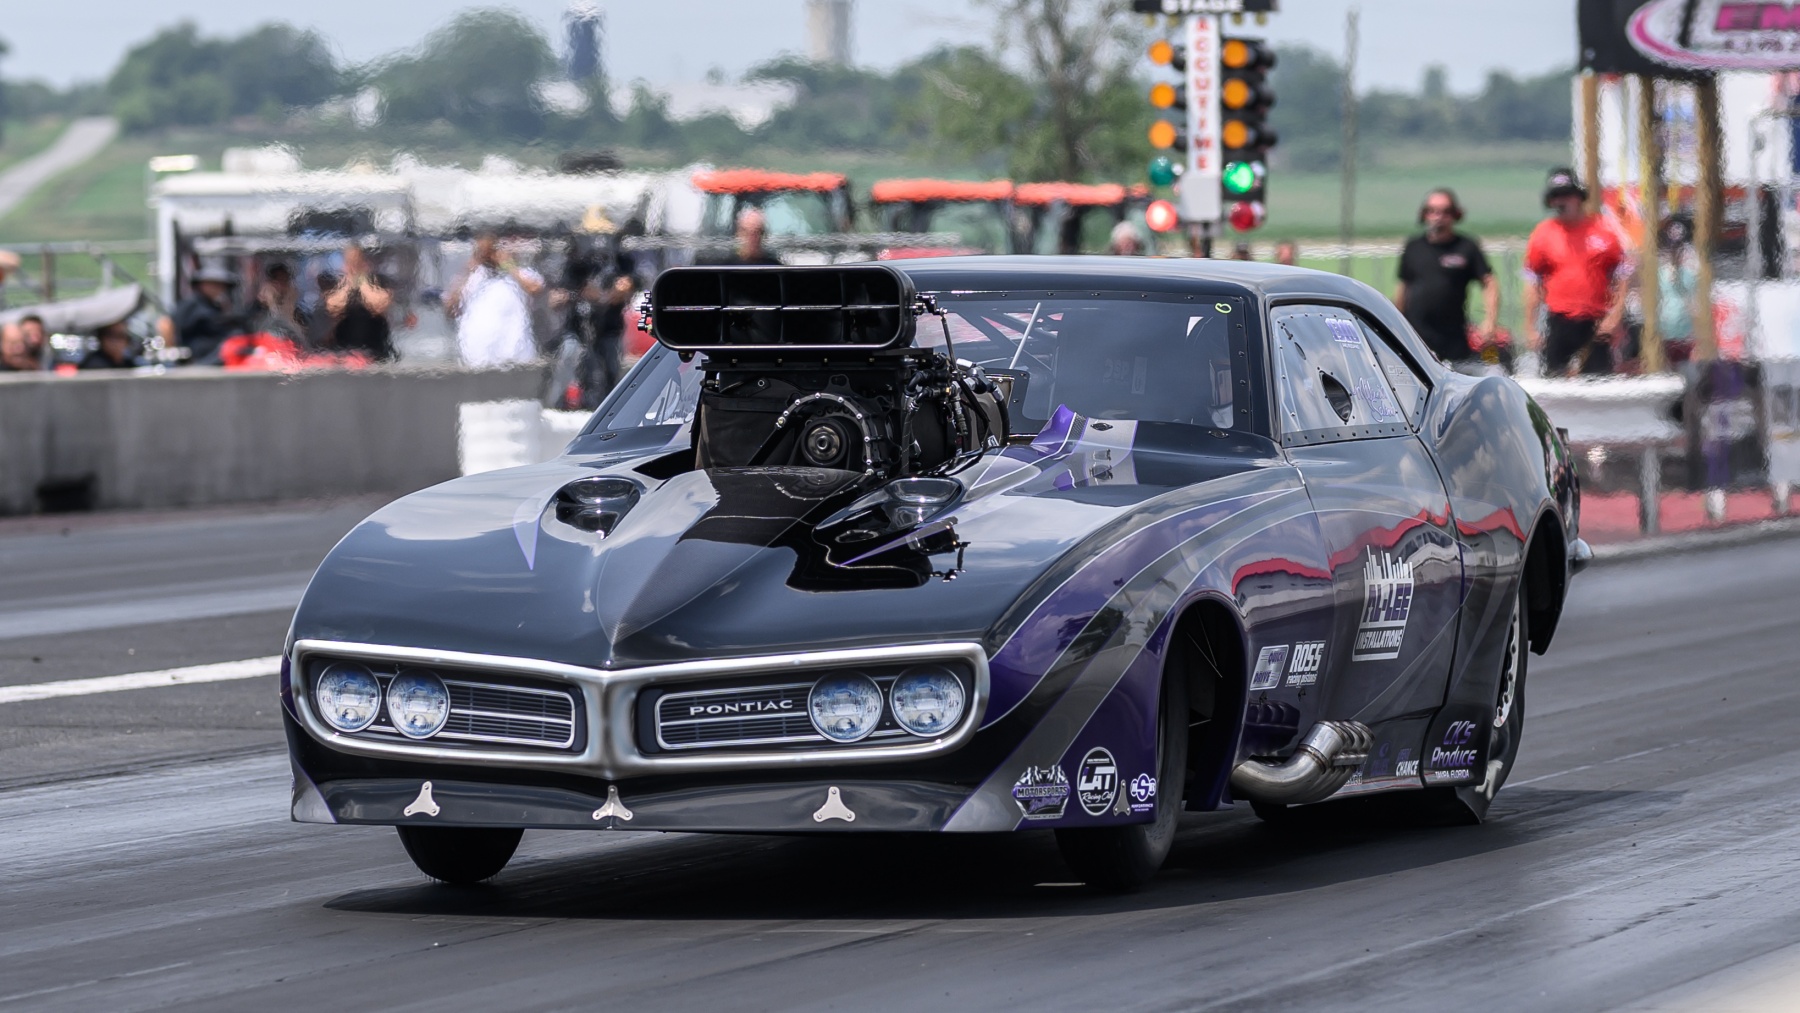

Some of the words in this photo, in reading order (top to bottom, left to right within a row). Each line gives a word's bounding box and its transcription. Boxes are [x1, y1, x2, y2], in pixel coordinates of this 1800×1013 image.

[1362, 583, 1412, 623] AL-LEE
[1356, 629, 1404, 650] INSTALLATIONS
[1289, 643, 1325, 673] ROSS
[689, 700, 793, 716] PONTIAC
[1079, 766, 1116, 790] LAT
[1395, 760, 1420, 777] CHANCE
[1017, 785, 1068, 798] MOTORSPORTS
[1082, 791, 1101, 803] Racing
